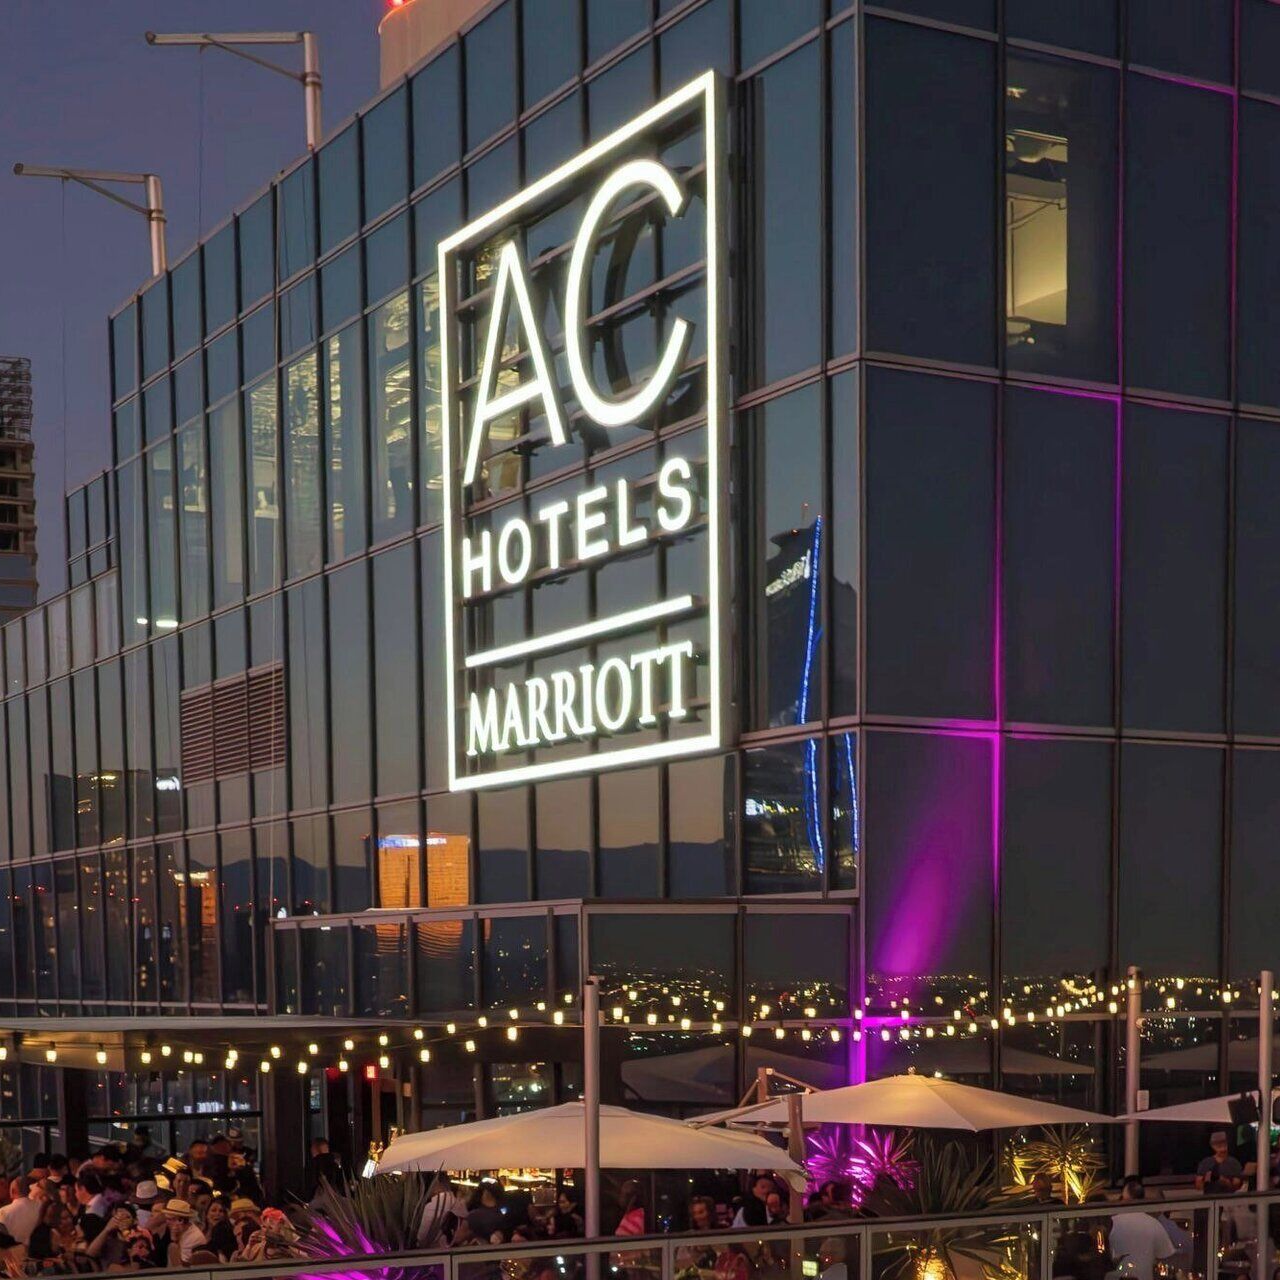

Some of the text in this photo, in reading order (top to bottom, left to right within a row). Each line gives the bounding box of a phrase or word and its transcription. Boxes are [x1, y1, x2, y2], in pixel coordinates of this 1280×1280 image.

[464, 159, 689, 486] AC
[462, 456, 693, 598] HOTELS
[467, 640, 694, 757] MARRIOTT
